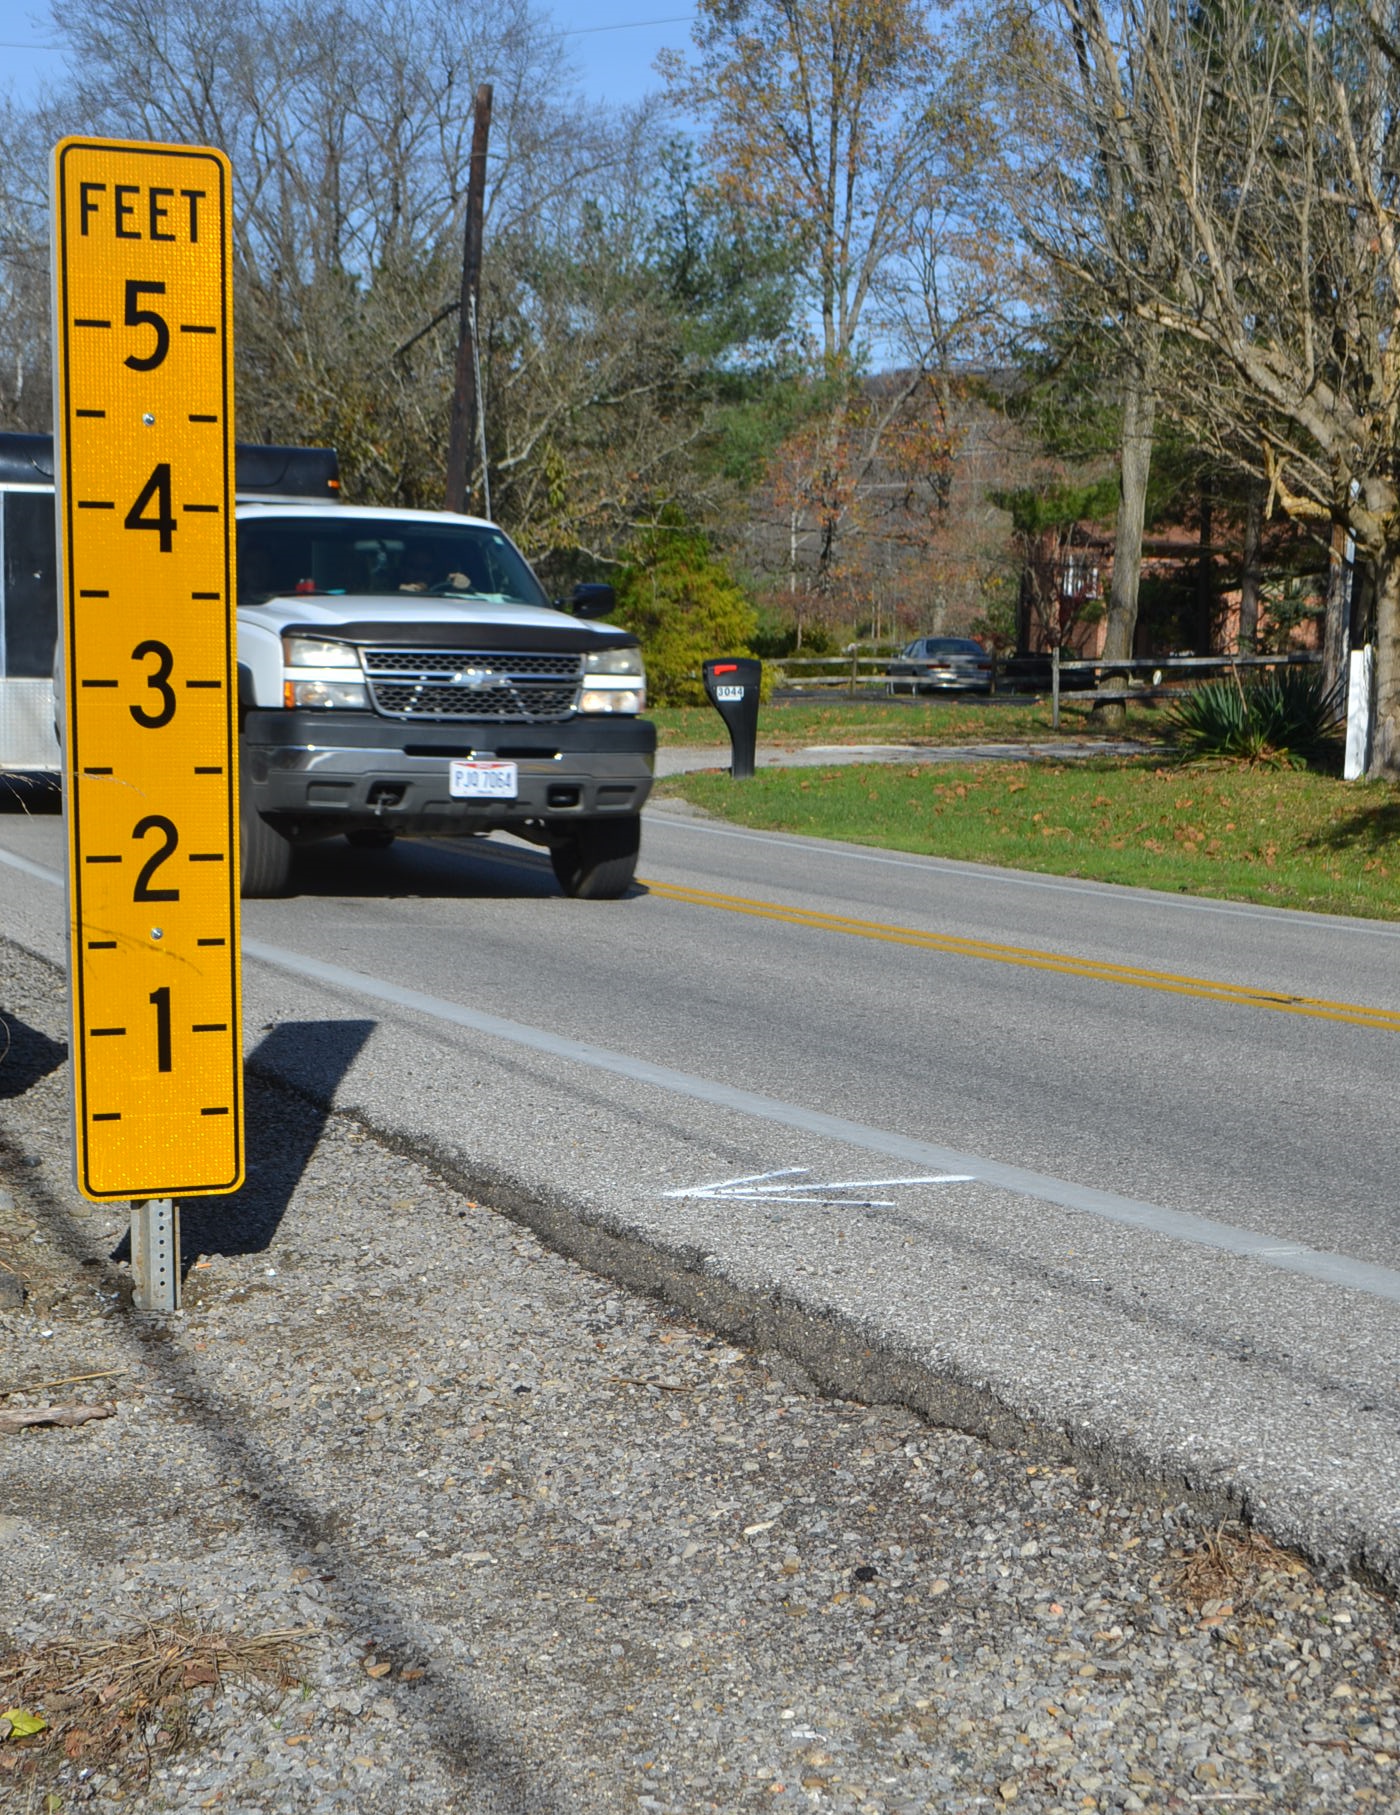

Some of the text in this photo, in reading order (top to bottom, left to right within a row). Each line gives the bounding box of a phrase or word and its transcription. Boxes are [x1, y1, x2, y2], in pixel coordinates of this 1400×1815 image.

[79, 181, 206, 243] FEET
[123, 279, 170, 372] 5
[124, 463, 178, 553] 4
[129, 639, 177, 729] 3
[718, 687, 743, 697] 3044
[131, 814, 180, 903] 2
[149, 986, 172, 1073] 1
